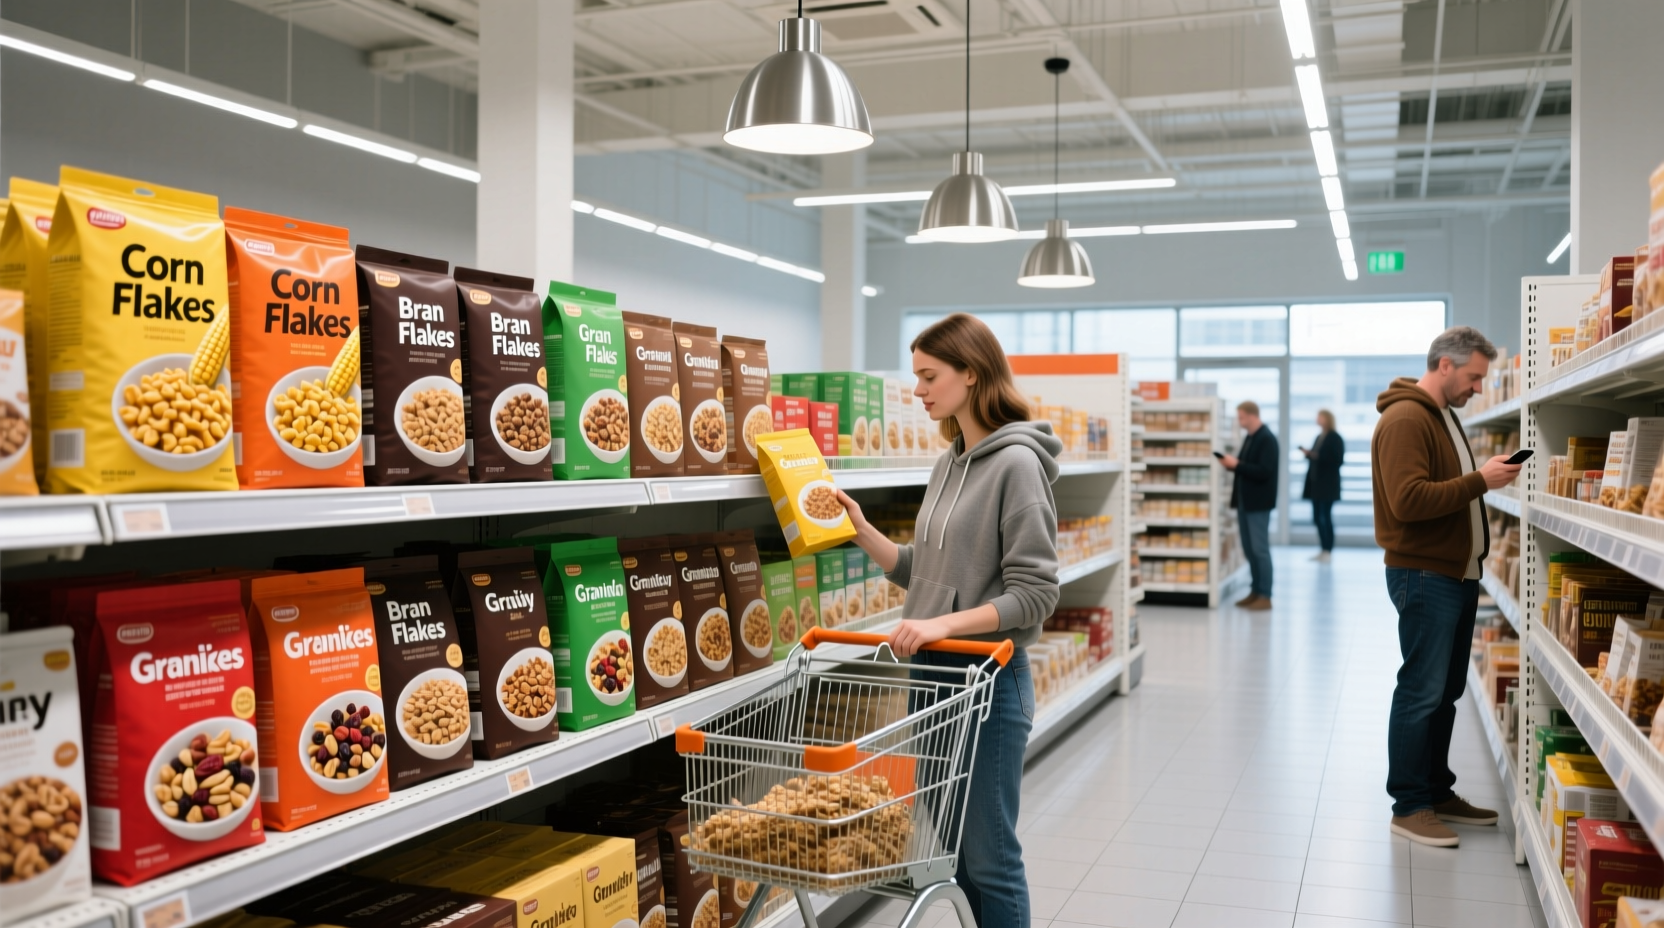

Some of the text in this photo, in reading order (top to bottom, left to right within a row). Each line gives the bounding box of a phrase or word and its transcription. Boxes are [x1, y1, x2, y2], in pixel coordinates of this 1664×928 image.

[121, 243, 204, 286] Corn
[270, 269, 340, 305] Corn
[112, 282, 215, 323] Flakes
[399, 296, 444, 323] Bran
[264, 303, 351, 339] Flakes
[490, 312, 531, 336] Bran
[578, 323, 612, 345] Gran
[399, 322, 455, 349] Flakes
[492, 335, 541, 359] Flakes
[386, 600, 432, 622] Bran
[391, 621, 446, 645] Flakes
